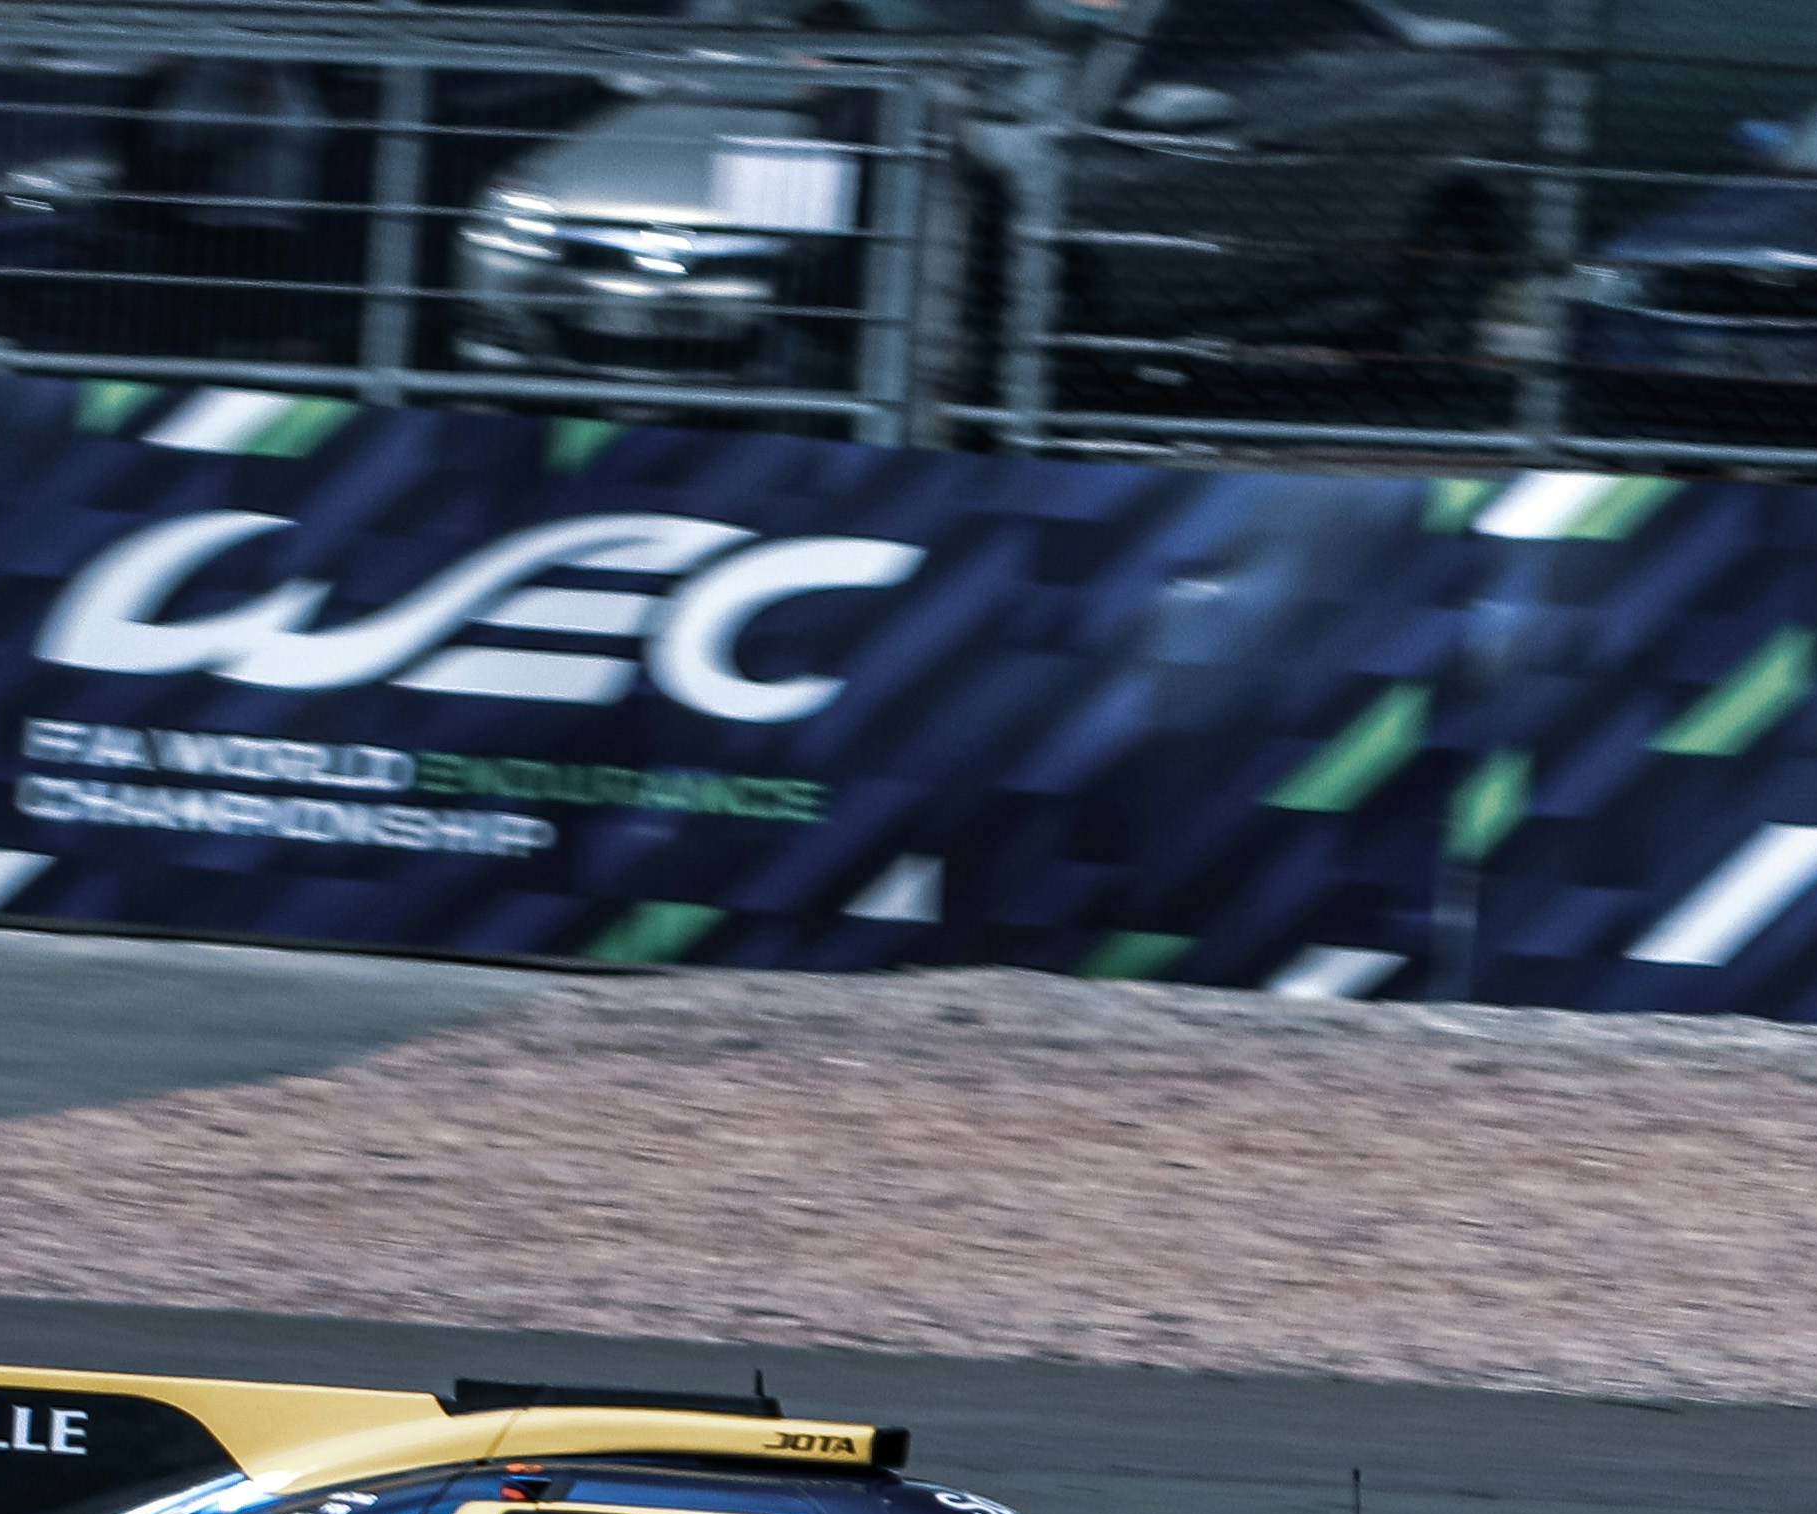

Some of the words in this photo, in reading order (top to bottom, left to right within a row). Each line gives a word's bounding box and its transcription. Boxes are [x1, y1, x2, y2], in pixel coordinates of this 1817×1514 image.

[33, 508, 929, 724] WEC
[15, 772, 559, 859] CHAMPIONSHIP
[151, 728, 416, 794] WORLD
[413, 749, 831, 825] ENDURANCE
[763, 1431, 858, 1455] JOTA
